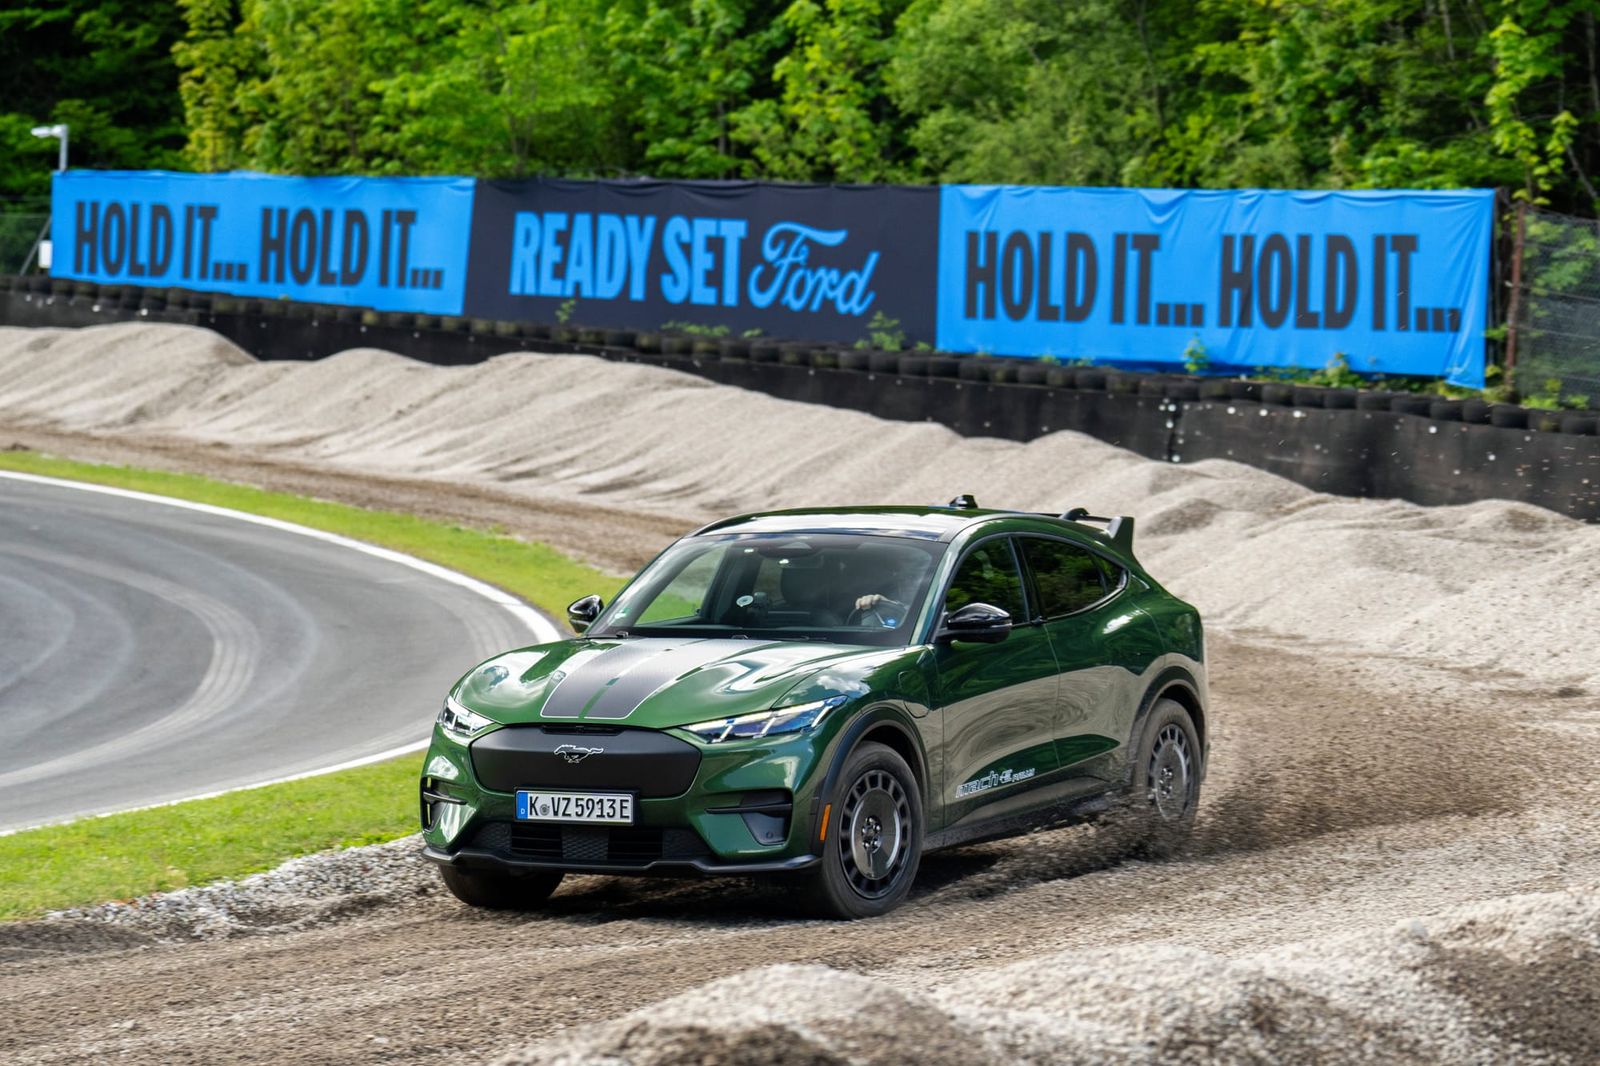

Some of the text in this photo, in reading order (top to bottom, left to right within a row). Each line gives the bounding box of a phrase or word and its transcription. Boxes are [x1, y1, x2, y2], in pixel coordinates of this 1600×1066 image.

[75, 202, 443, 289] HOLD IT... HOLD IT...
[509, 212, 880, 316] READY SET Ford
[965, 231, 1461, 333] HOLD IT... HOLD IT...
[529, 796, 539, 817] K
[551, 797, 572, 817] VZ
